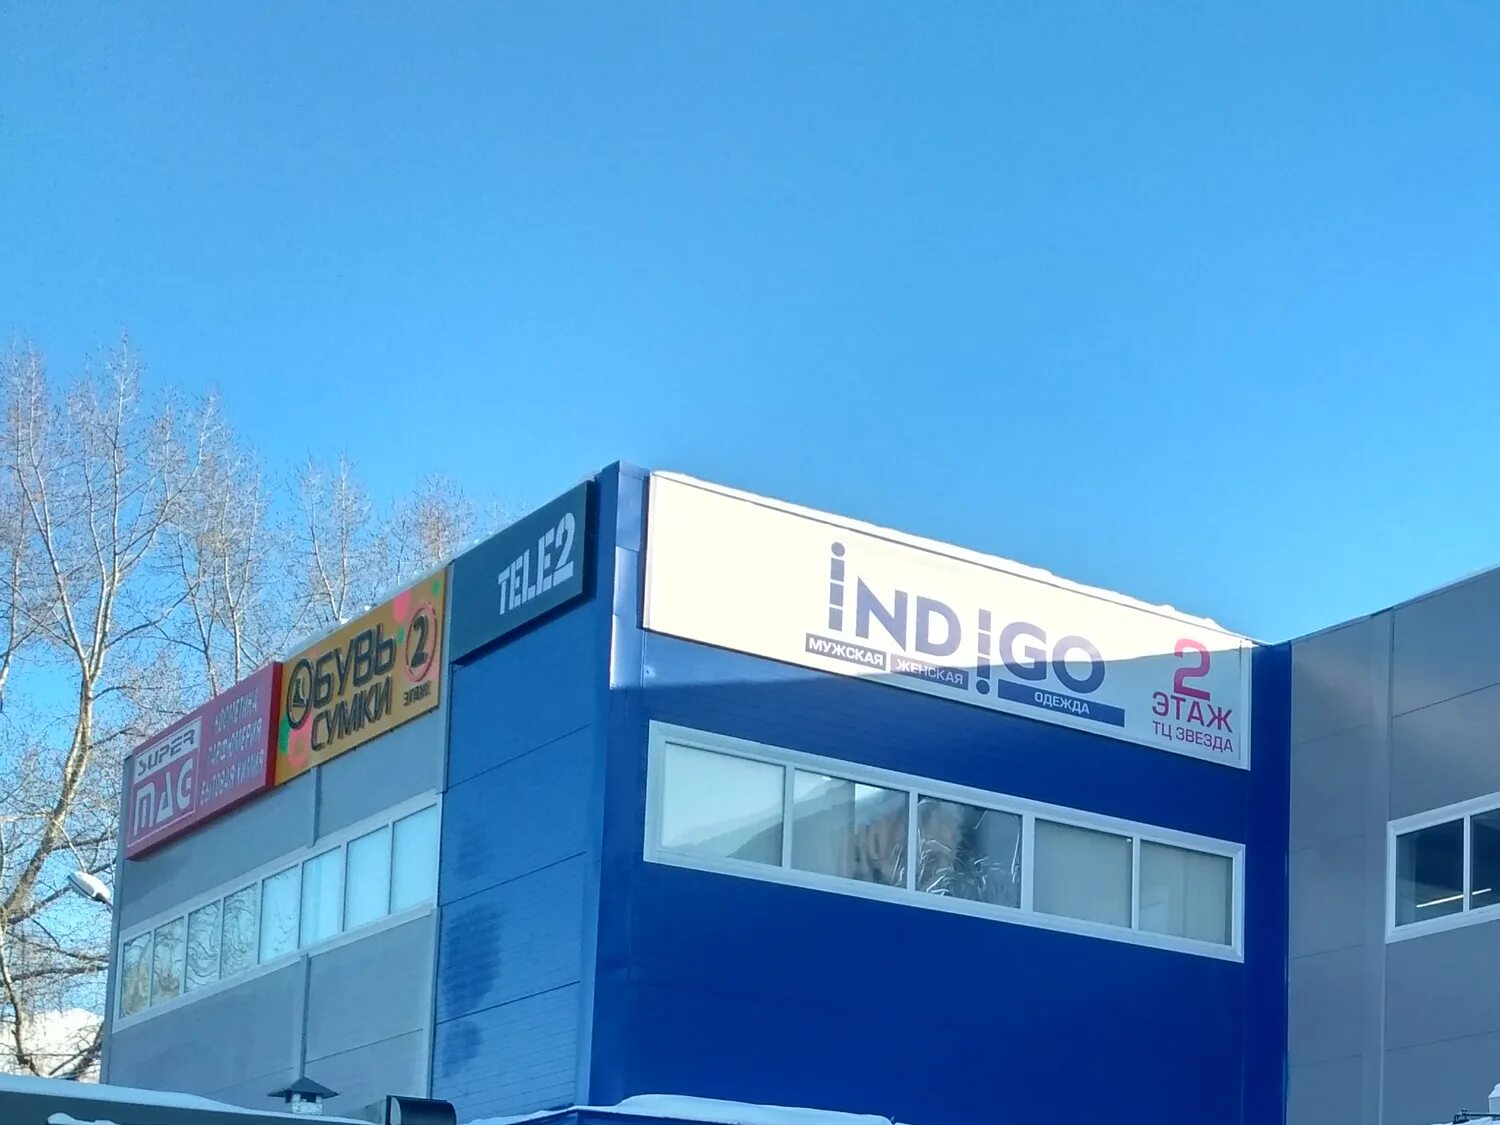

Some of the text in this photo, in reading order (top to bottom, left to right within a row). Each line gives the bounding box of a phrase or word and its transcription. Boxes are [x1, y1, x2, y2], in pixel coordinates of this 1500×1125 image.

[498, 512, 576, 615] TELE2
[411, 615, 429, 668] 2
[808, 637, 884, 668] МУЖСКАЯ
[287, 623, 397, 730] ОБУВЬ
[896, 659, 964, 686] ЖЕНСКАЯ
[1173, 638, 1212, 702] 2
[311, 676, 393, 751] СУМКИ
[1034, 691, 1091, 716] ОДЕЖДА
[1152, 690, 1233, 734] ЭТАЖ
[138, 729, 196, 777] SUPER
[1152, 719, 1234, 754] ТЦ ЗВЕЗДА
